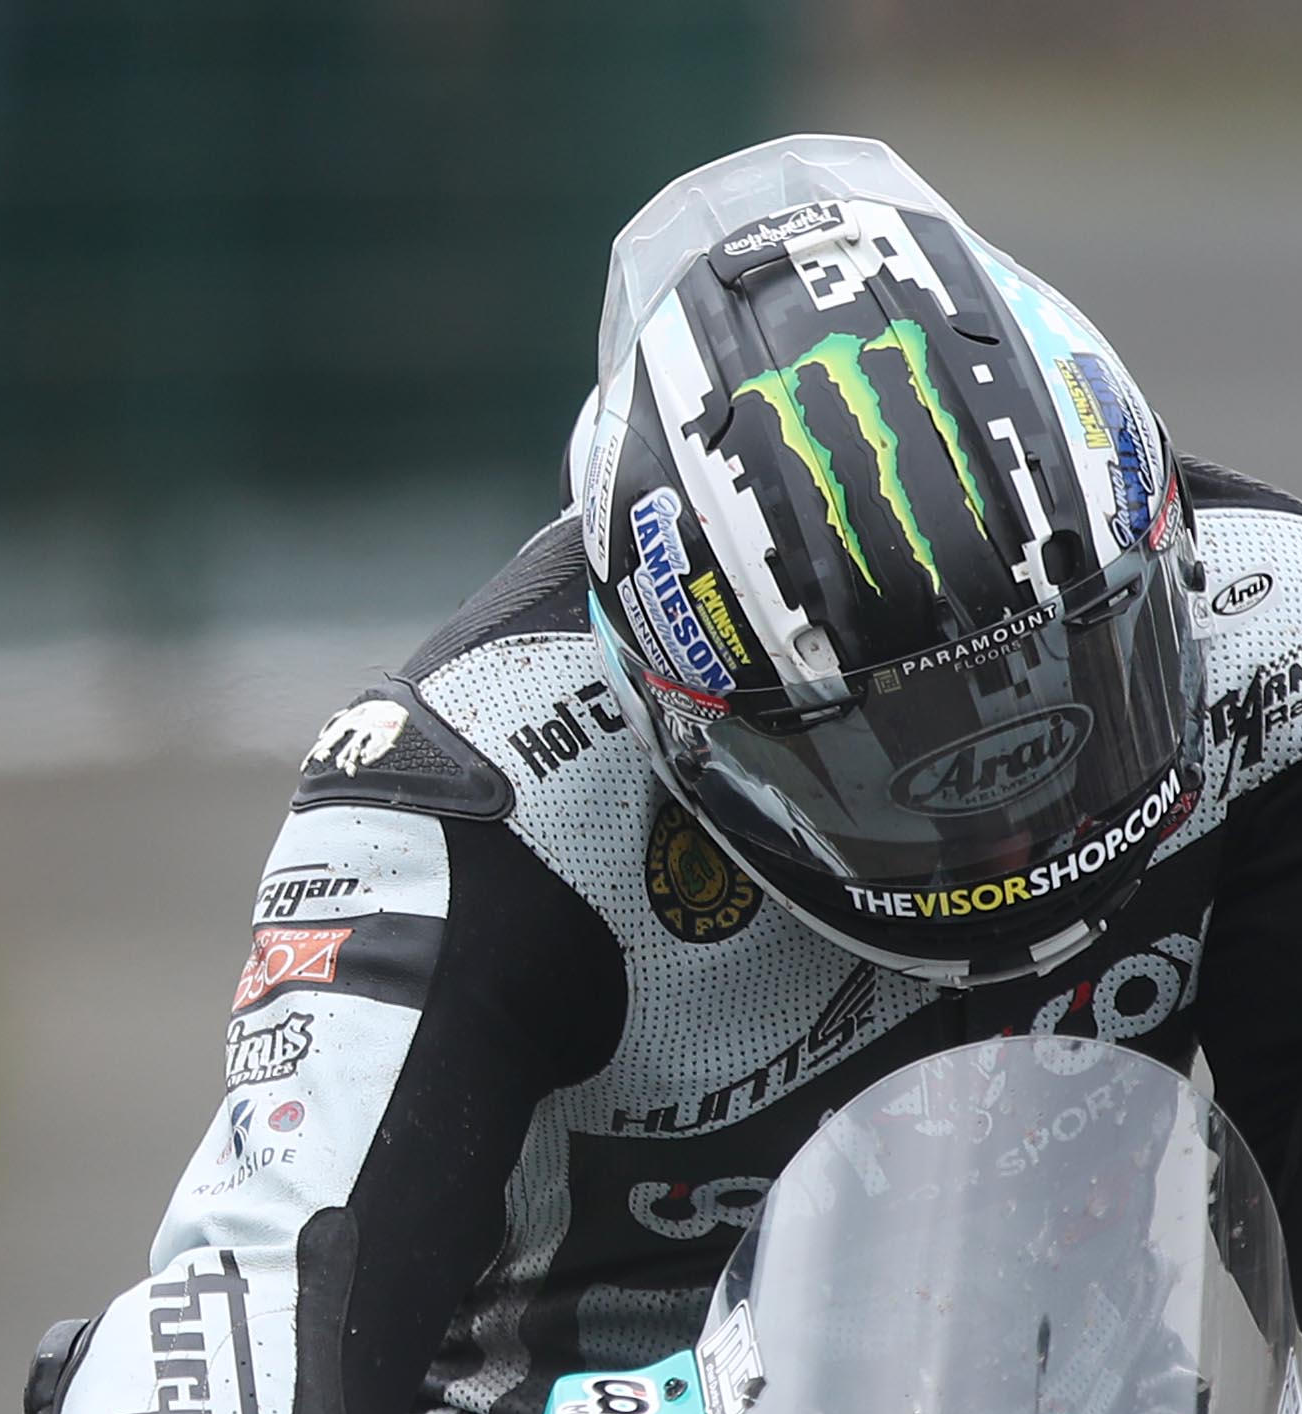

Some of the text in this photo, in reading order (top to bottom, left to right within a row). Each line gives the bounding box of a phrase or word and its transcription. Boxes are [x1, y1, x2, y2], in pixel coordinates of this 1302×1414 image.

[632, 502, 732, 695] JAMIESON
[688, 571, 752, 667] McKINSTRY
[1225, 574, 1265, 606] Arai
[902, 604, 1057, 676] PARAMOUNT
[954, 640, 1023, 673] FLOORS
[932, 712, 1073, 798] Arai
[845, 768, 1182, 920] THEVISORSHOP.COM
